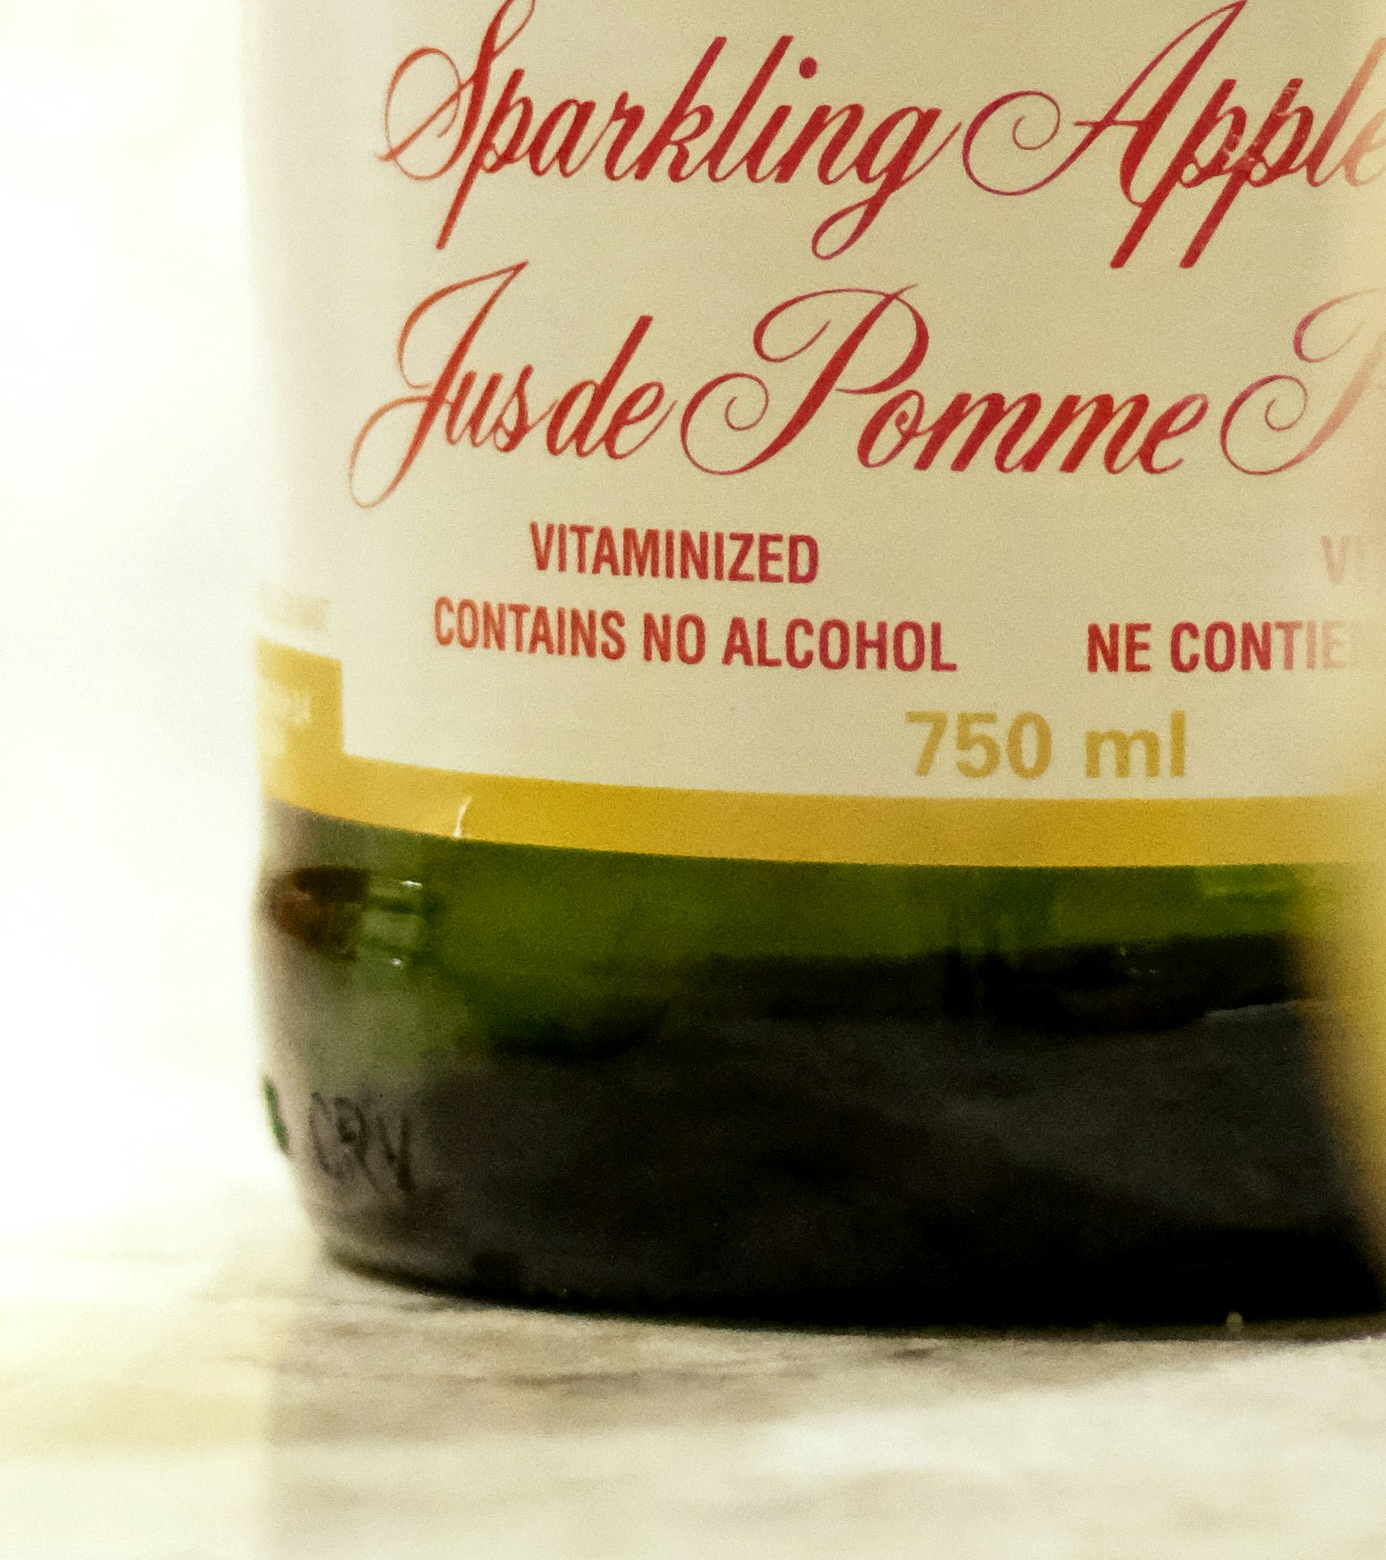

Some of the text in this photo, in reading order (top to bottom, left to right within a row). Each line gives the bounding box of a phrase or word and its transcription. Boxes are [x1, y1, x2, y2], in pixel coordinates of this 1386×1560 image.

[349, 260, 558, 509] Jus
[545, 314, 679, 461] de
[679, 282, 1210, 477] Pomme
[529, 520, 821, 585] VITAMINIZED
[432, 595, 959, 673] CONTAINS NO ALCOHOL
[1085, 618, 1368, 674] NE CONTIE
[904, 709, 1187, 780] 750 ml
